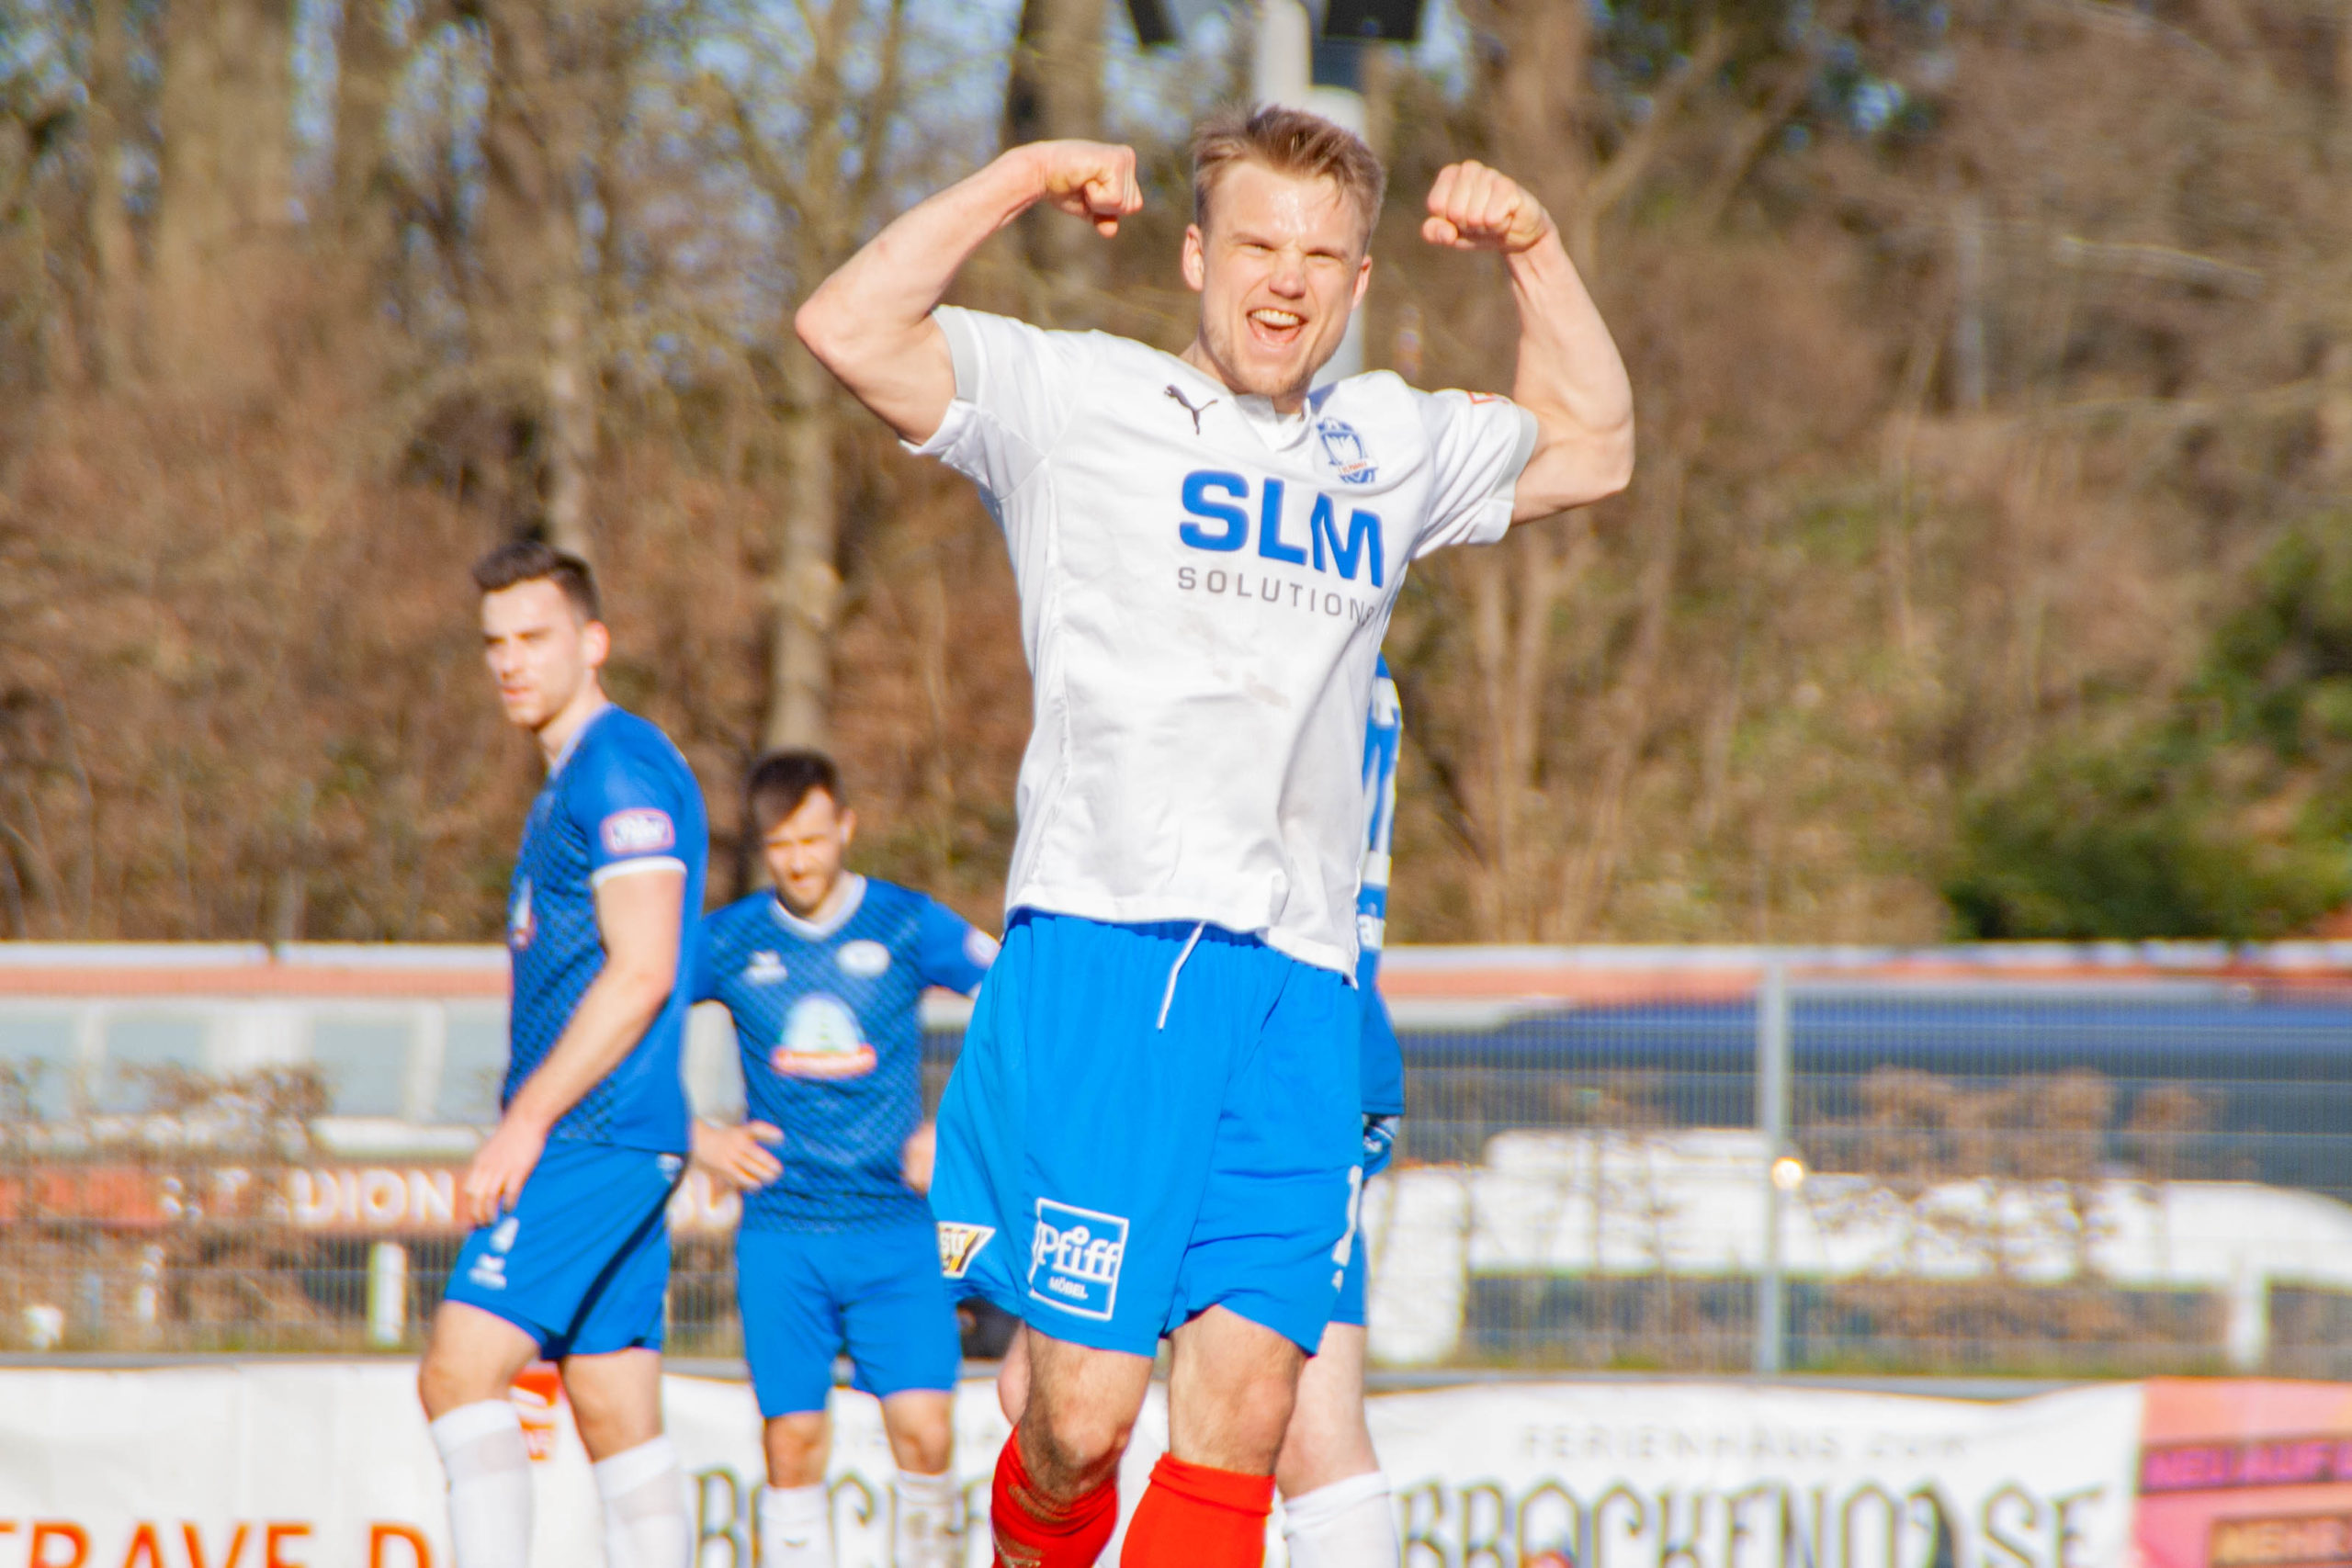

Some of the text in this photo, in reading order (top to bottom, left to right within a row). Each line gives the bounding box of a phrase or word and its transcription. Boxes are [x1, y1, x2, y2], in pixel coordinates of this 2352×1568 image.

[1180, 469, 1384, 589] SLM
[1035, 1220, 1121, 1282] Pfiff
[1048, 1276, 1089, 1300] MÖBEL
[1521, 1423, 1840, 1459] FERIENHAUS
